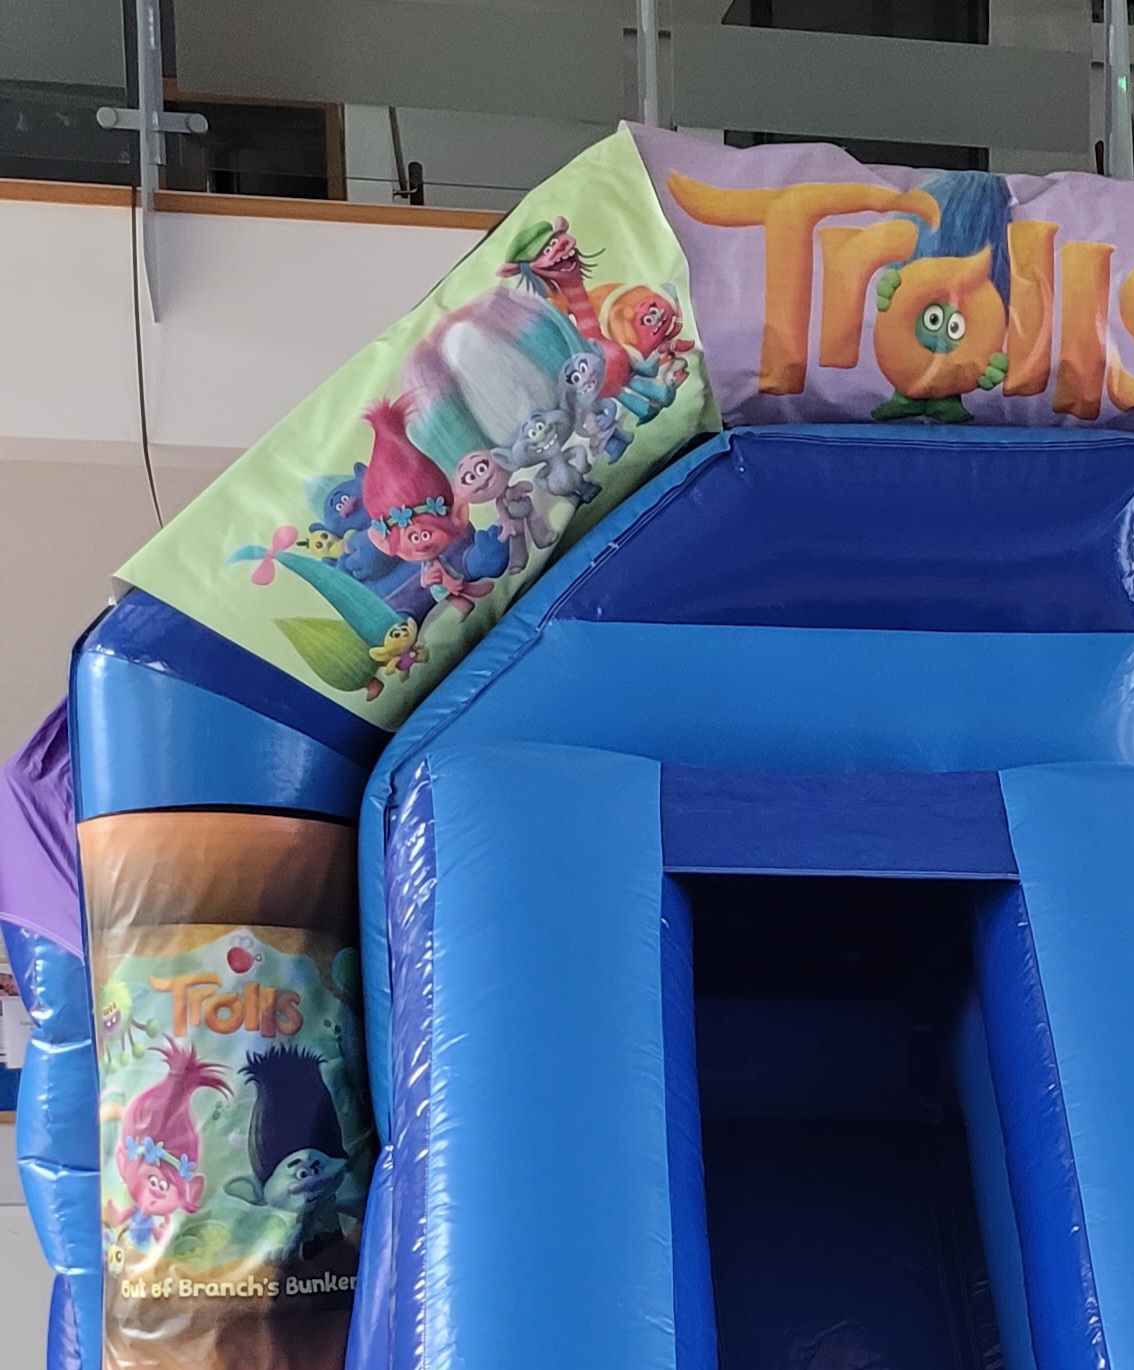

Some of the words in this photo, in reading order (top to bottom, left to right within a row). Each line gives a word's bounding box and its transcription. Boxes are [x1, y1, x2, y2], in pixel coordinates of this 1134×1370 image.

[150, 973, 304, 1038] Trolls
[121, 1277, 147, 1298] Out
[151, 1277, 172, 1298] of
[178, 1275, 280, 1297] Branch's
